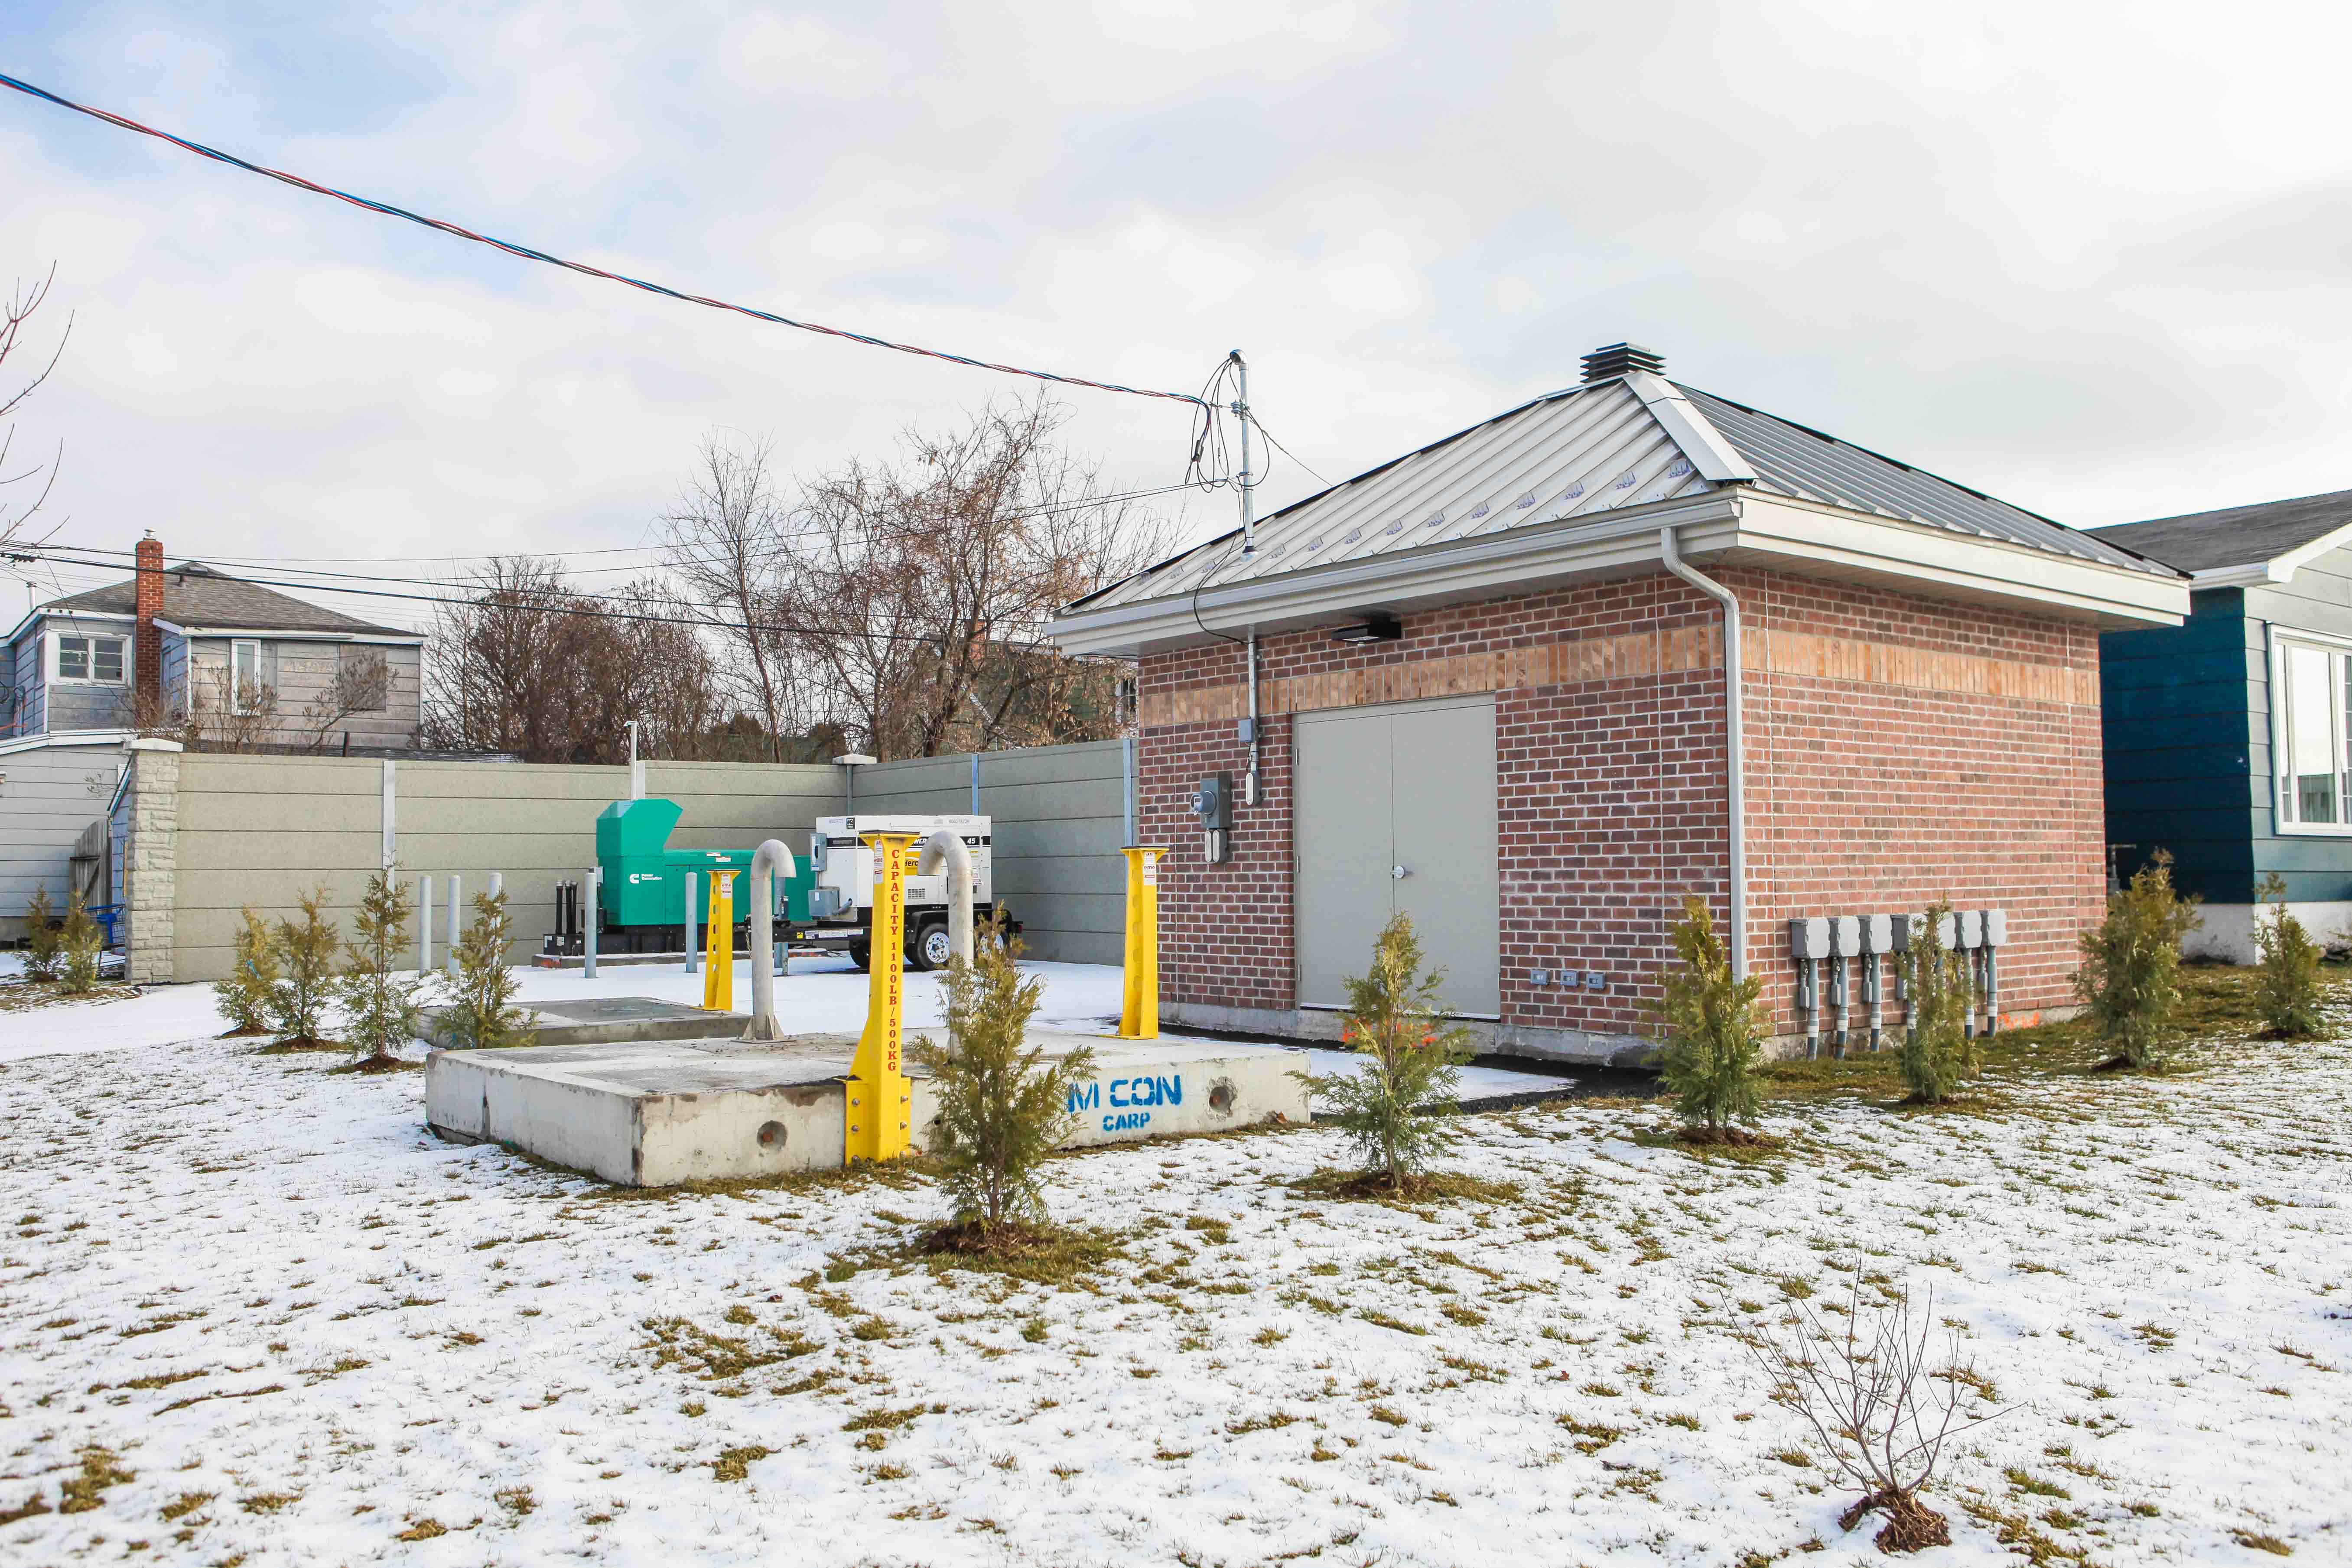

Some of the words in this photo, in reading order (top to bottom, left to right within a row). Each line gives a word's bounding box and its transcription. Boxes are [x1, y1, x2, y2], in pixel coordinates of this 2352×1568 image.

[890, 849, 900, 935] CAPACITY
[888, 942, 898, 1071] 1100LB/500KG
[1109, 1075, 1182, 1107] CON
[1103, 1112, 1151, 1132] CARP
